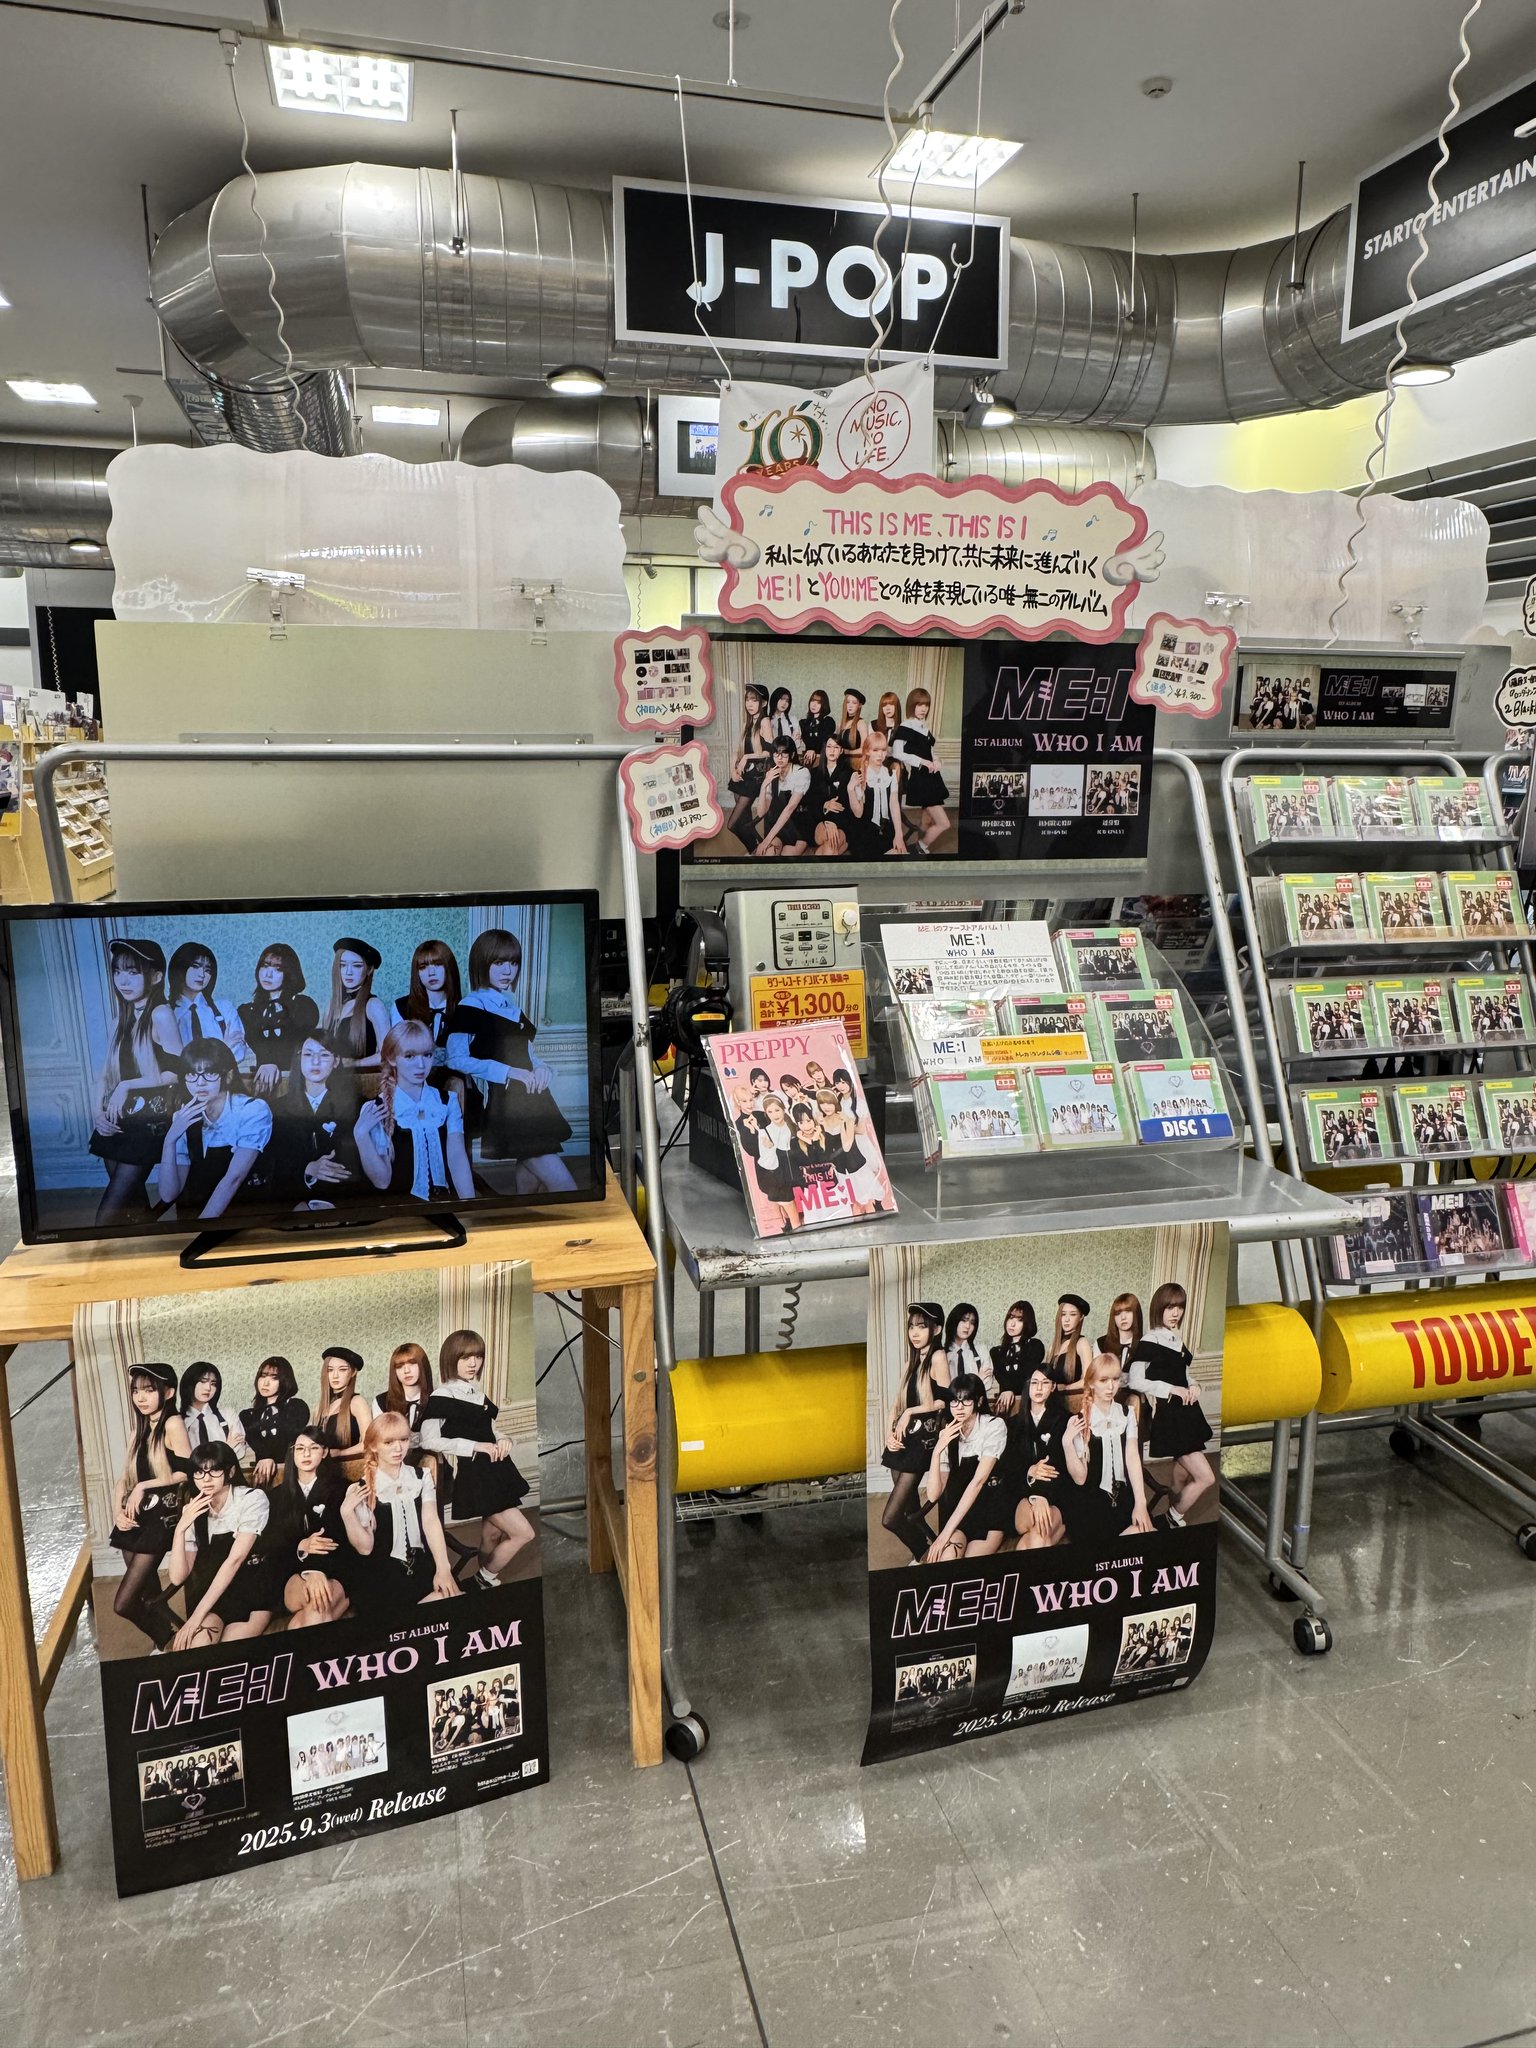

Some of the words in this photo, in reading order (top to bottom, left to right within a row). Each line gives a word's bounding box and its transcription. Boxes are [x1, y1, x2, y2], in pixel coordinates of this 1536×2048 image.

[1364, 213, 1427, 260] STARTO
[686, 232, 948, 321] J-POP
[757, 459, 800, 477] YEARS
[822, 509, 873, 535] THIS
[880, 512, 898, 536] IS
[942, 513, 991, 538] THIS
[997, 514, 1016, 539] IS
[1021, 515, 1028, 540] I
[988, 667, 1133, 721] ME:I
[1324, 675, 1379, 697] ME:I
[1323, 710, 1349, 720] WHO
[1352, 711, 1357, 720] I
[1359, 711, 1375, 720] AM
[974, 738, 989, 747] 1ST
[990, 738, 1023, 747] ALBUM
[1032, 733, 1089, 752] WHO
[1096, 733, 1105, 752] I
[1110, 735, 1143, 752] AM
[950, 933, 986, 946] ME:I
[946, 949, 968, 957] WHO
[777, 991, 845, 1017] ¥1,300
[720, 1035, 810, 1065] PREPPY
[832, 1034, 845, 1047] 10
[933, 1041, 966, 1054] ME:I
[922, 1058, 943, 1066] WHO
[1161, 1119, 1198, 1137] DISC
[1201, 1119, 1211, 1134] 1
[1431, 1193, 1464, 1211] ME:I
[1096, 1562, 1110, 1572] 1ST
[1111, 1557, 1144, 1569] ALBUM
[1030, 1577, 1118, 1614] WHO
[1131, 1570, 1143, 1598] I
[1151, 1562, 1200, 1595] AM
[891, 1573, 1019, 1639] ME:I
[388, 1631, 407, 1643] 1ST
[408, 1621, 450, 1639] ALBUM
[307, 1648, 419, 1691] WHO
[434, 1636, 450, 1664] I
[460, 1620, 522, 1659] AM
[131, 1653, 294, 1734] ME:I
[1052, 1692, 1116, 1714] Release
[367, 1785, 447, 1821] Release
